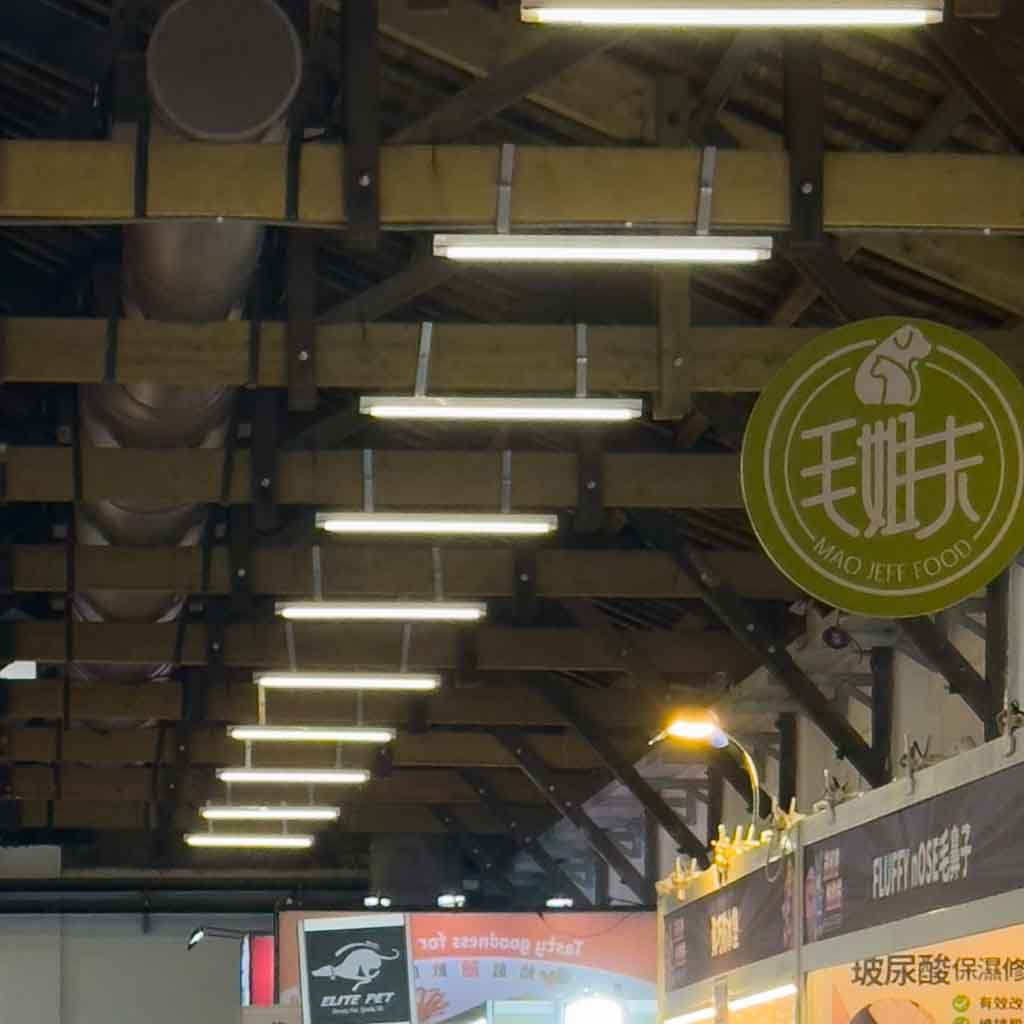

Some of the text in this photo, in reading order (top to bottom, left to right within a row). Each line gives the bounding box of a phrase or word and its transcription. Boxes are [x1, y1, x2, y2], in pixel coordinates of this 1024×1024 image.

[813, 536, 973, 584] MAO JEFF FOOD
[872, 848, 910, 899] FLUFFY
[320, 992, 395, 1007] ELITE PET
